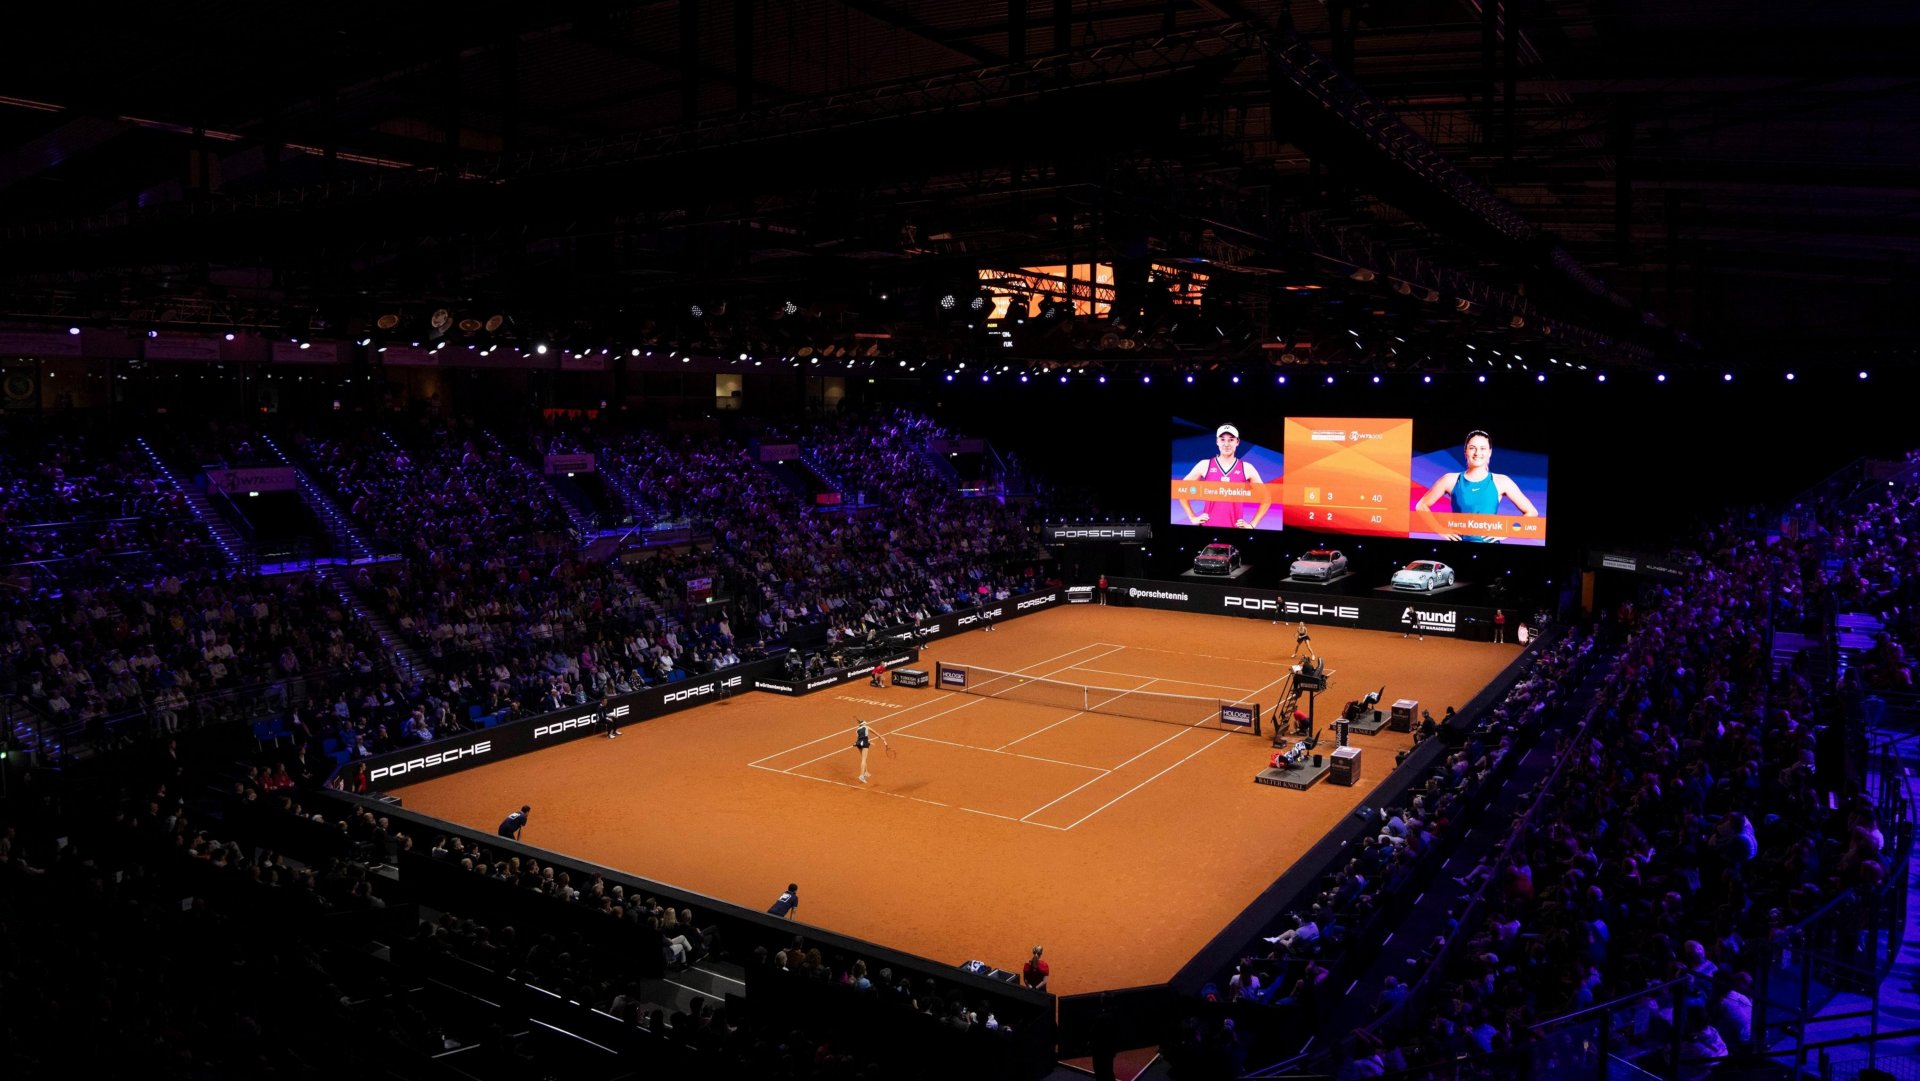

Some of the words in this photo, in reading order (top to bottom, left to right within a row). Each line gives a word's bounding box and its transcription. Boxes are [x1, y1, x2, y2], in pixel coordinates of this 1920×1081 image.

[1219, 487, 1252, 497] Rybakina
[1309, 491, 1315, 499] 6
[1327, 492, 1333, 500] 3
[1309, 512, 1315, 520] 2
[1371, 515, 1382, 523] AD
[1468, 520, 1503, 530] Kostyuk
[1054, 530, 1136, 538] PORSCHE
[1065, 585, 1096, 593] BOSE
[1129, 587, 1189, 601] @porschetennis
[1017, 593, 1056, 610] PORSCHE
[1224, 596, 1359, 619] PORSCHE
[958, 608, 1002, 626] PORCHE
[1401, 607, 1457, 623] Amundi
[894, 624, 940, 641] RCHE
[943, 671, 964, 679] HOLOGIC
[1223, 709, 1251, 719] HOLOGIC
[370, 740, 491, 782] PORSCHE
[1257, 777, 1282, 786] WALTER
